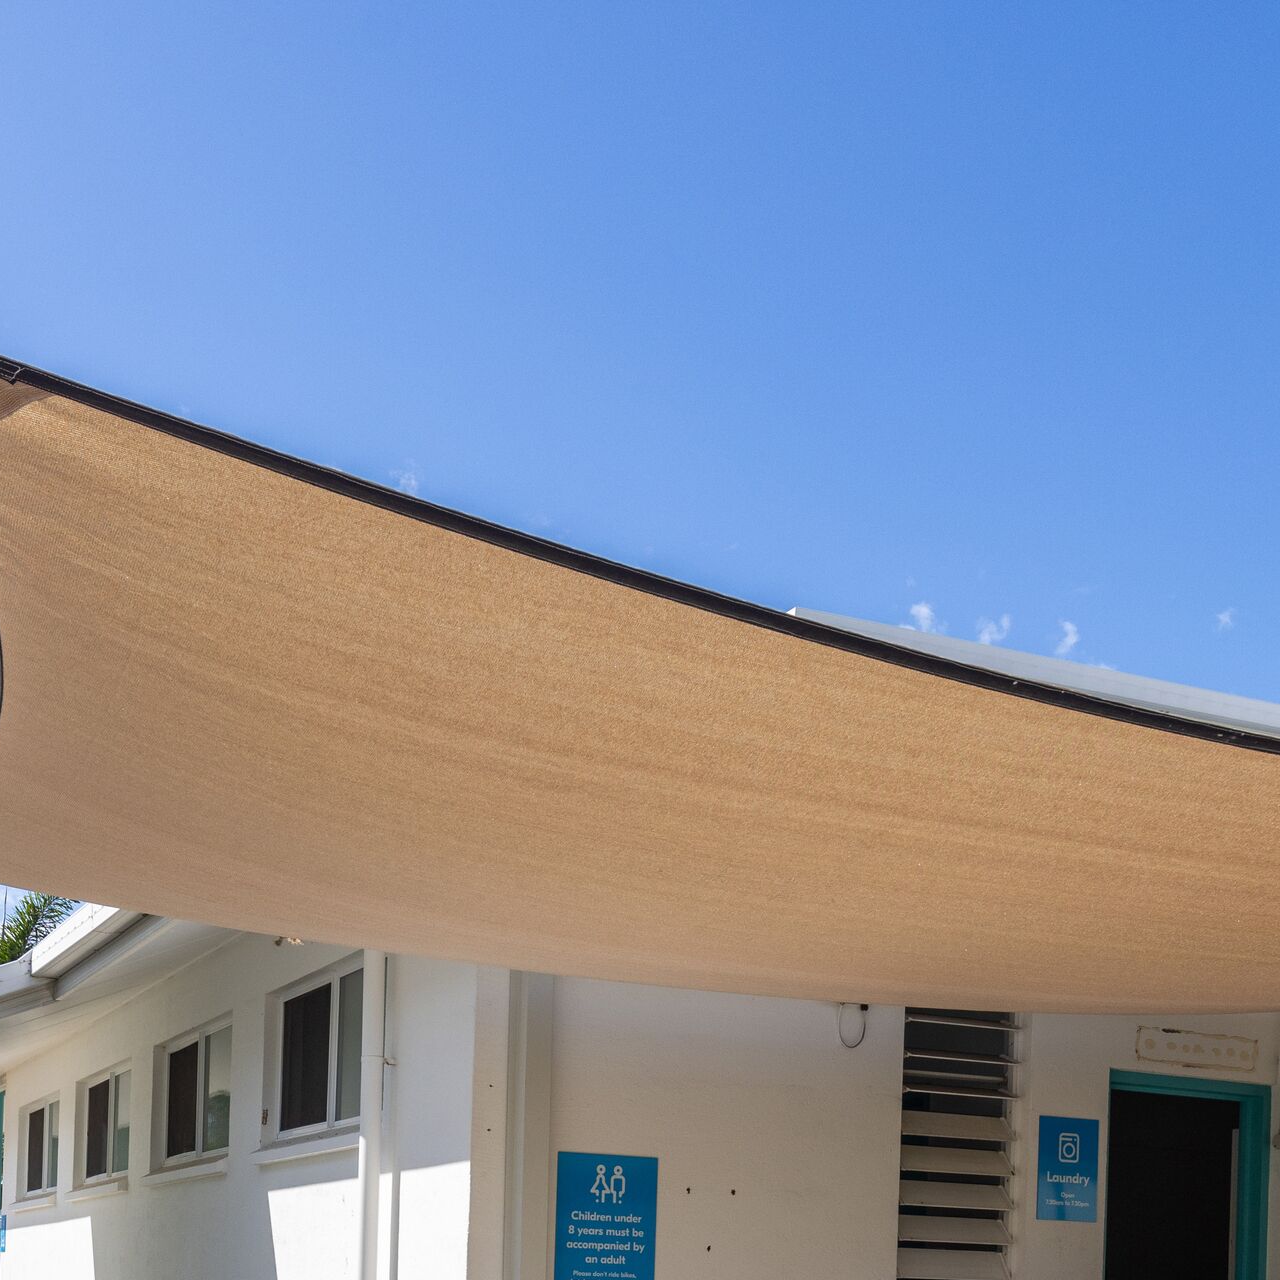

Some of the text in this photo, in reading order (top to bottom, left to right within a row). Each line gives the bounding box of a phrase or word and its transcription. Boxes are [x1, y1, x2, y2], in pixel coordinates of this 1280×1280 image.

[1047, 1170, 1090, 1187] Laundry
[571, 1210, 642, 1223] Children under
[568, 1225, 644, 1237] 8 years must be
[566, 1241, 645, 1254] accompanied by
[585, 1255, 626, 1265] an adult
[572, 1269, 592, 1277] Please
